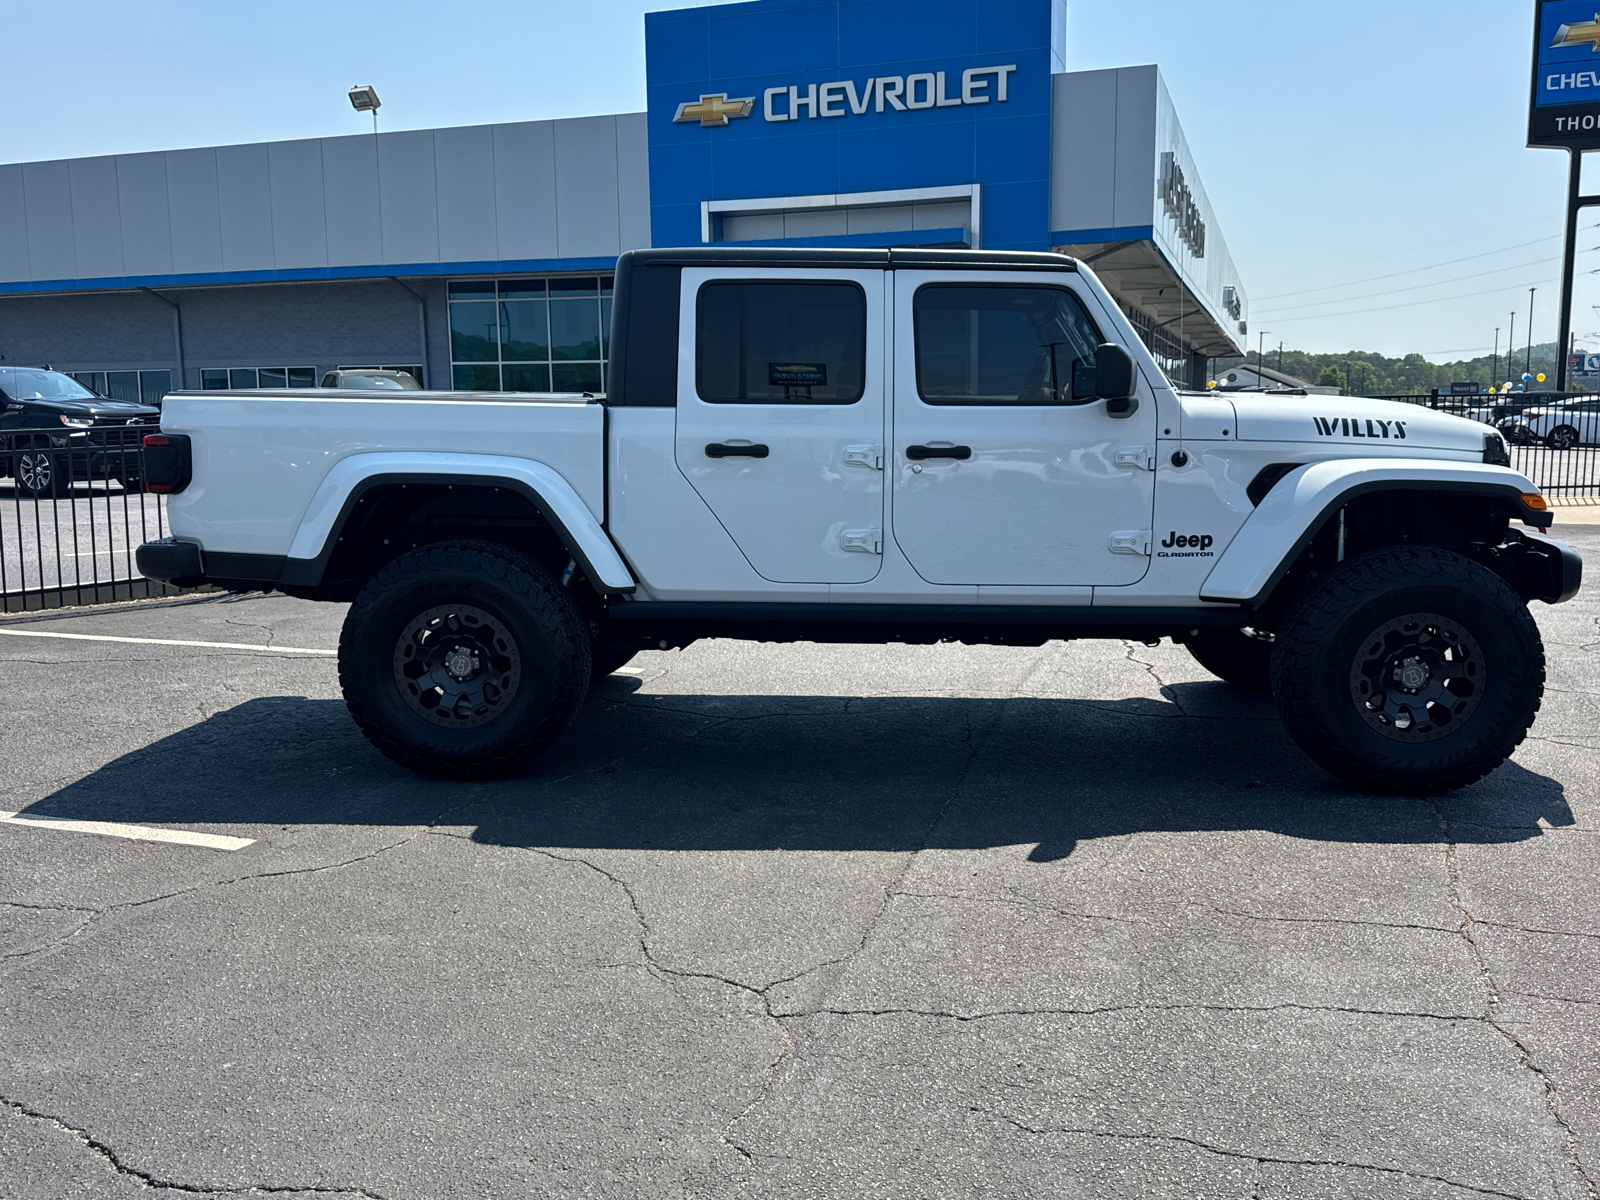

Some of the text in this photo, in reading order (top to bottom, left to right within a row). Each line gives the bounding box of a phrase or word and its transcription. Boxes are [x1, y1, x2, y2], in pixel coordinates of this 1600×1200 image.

[763, 64, 1017, 122] CHEVROLET
[1312, 416, 1407, 440] WILLYS
[1161, 531, 1213, 550] Jeep
